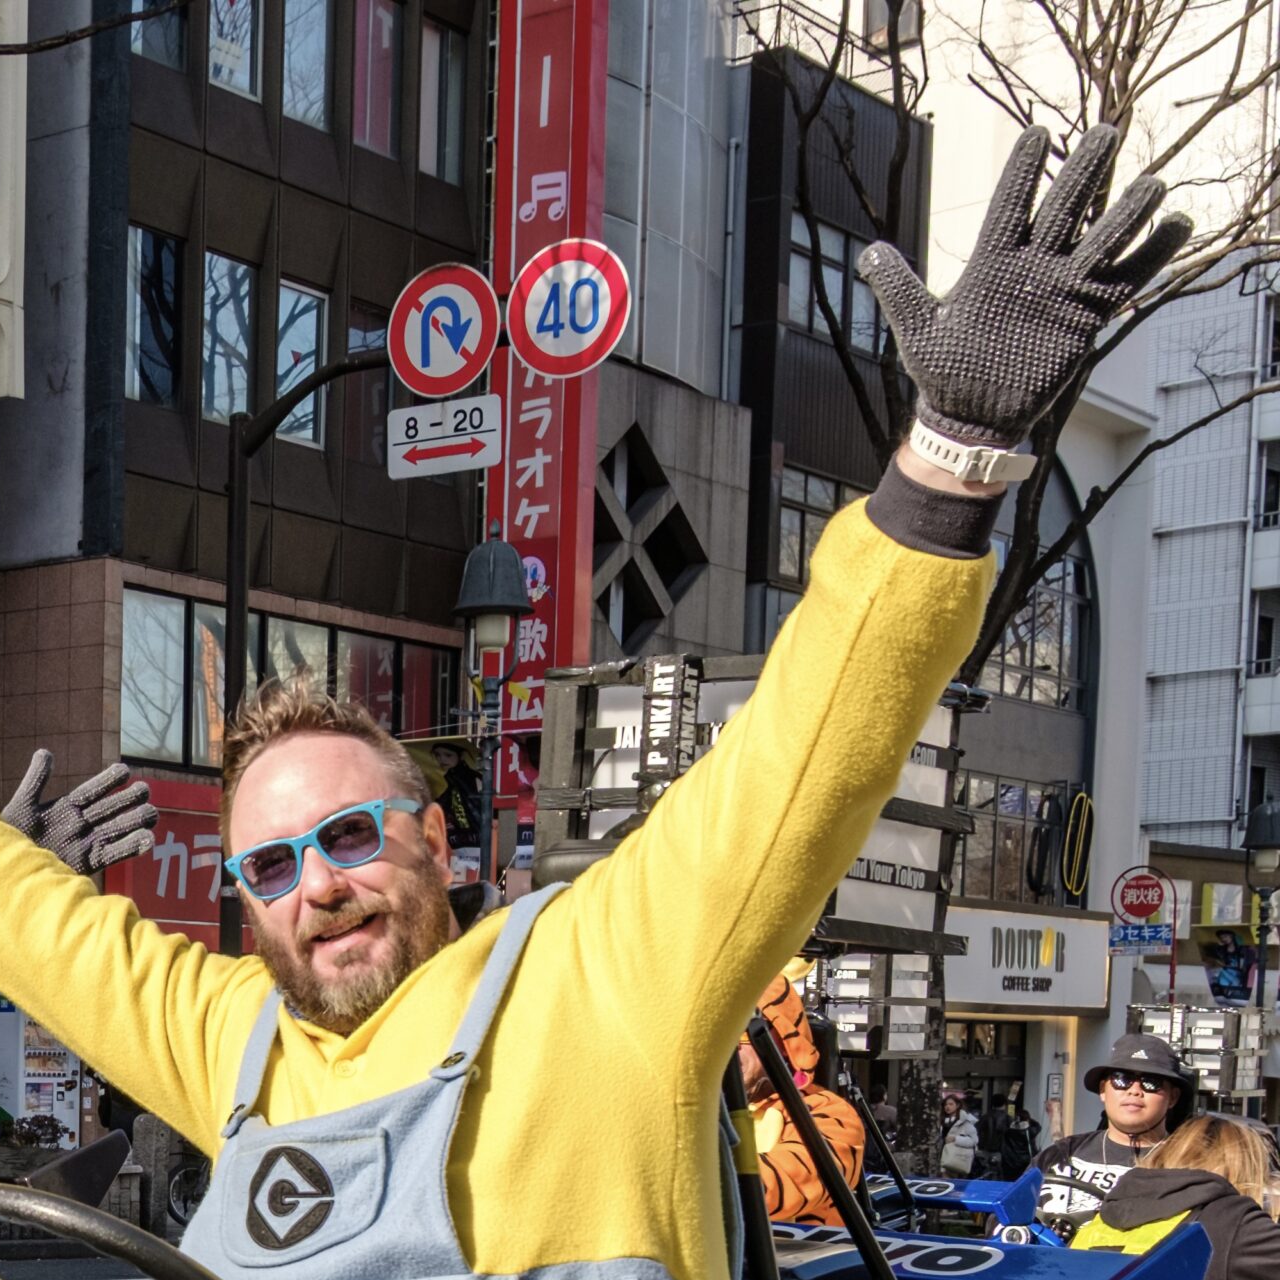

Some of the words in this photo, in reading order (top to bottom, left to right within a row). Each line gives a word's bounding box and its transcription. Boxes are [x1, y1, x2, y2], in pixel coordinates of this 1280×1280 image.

[536, 277, 600, 339] 40
[404, 416, 419, 440] 8
[452, 407, 484, 433] 20
[152, 830, 222, 903] カラ
[869, 860, 894, 884] Your
[894, 864, 926, 890] Tokyo
[1123, 887, 1161, 905] 消火栓
[991, 924, 1066, 973] DOUTOR
[1002, 975, 1031, 992] COFFEE
[1031, 977, 1053, 993] SHOP
